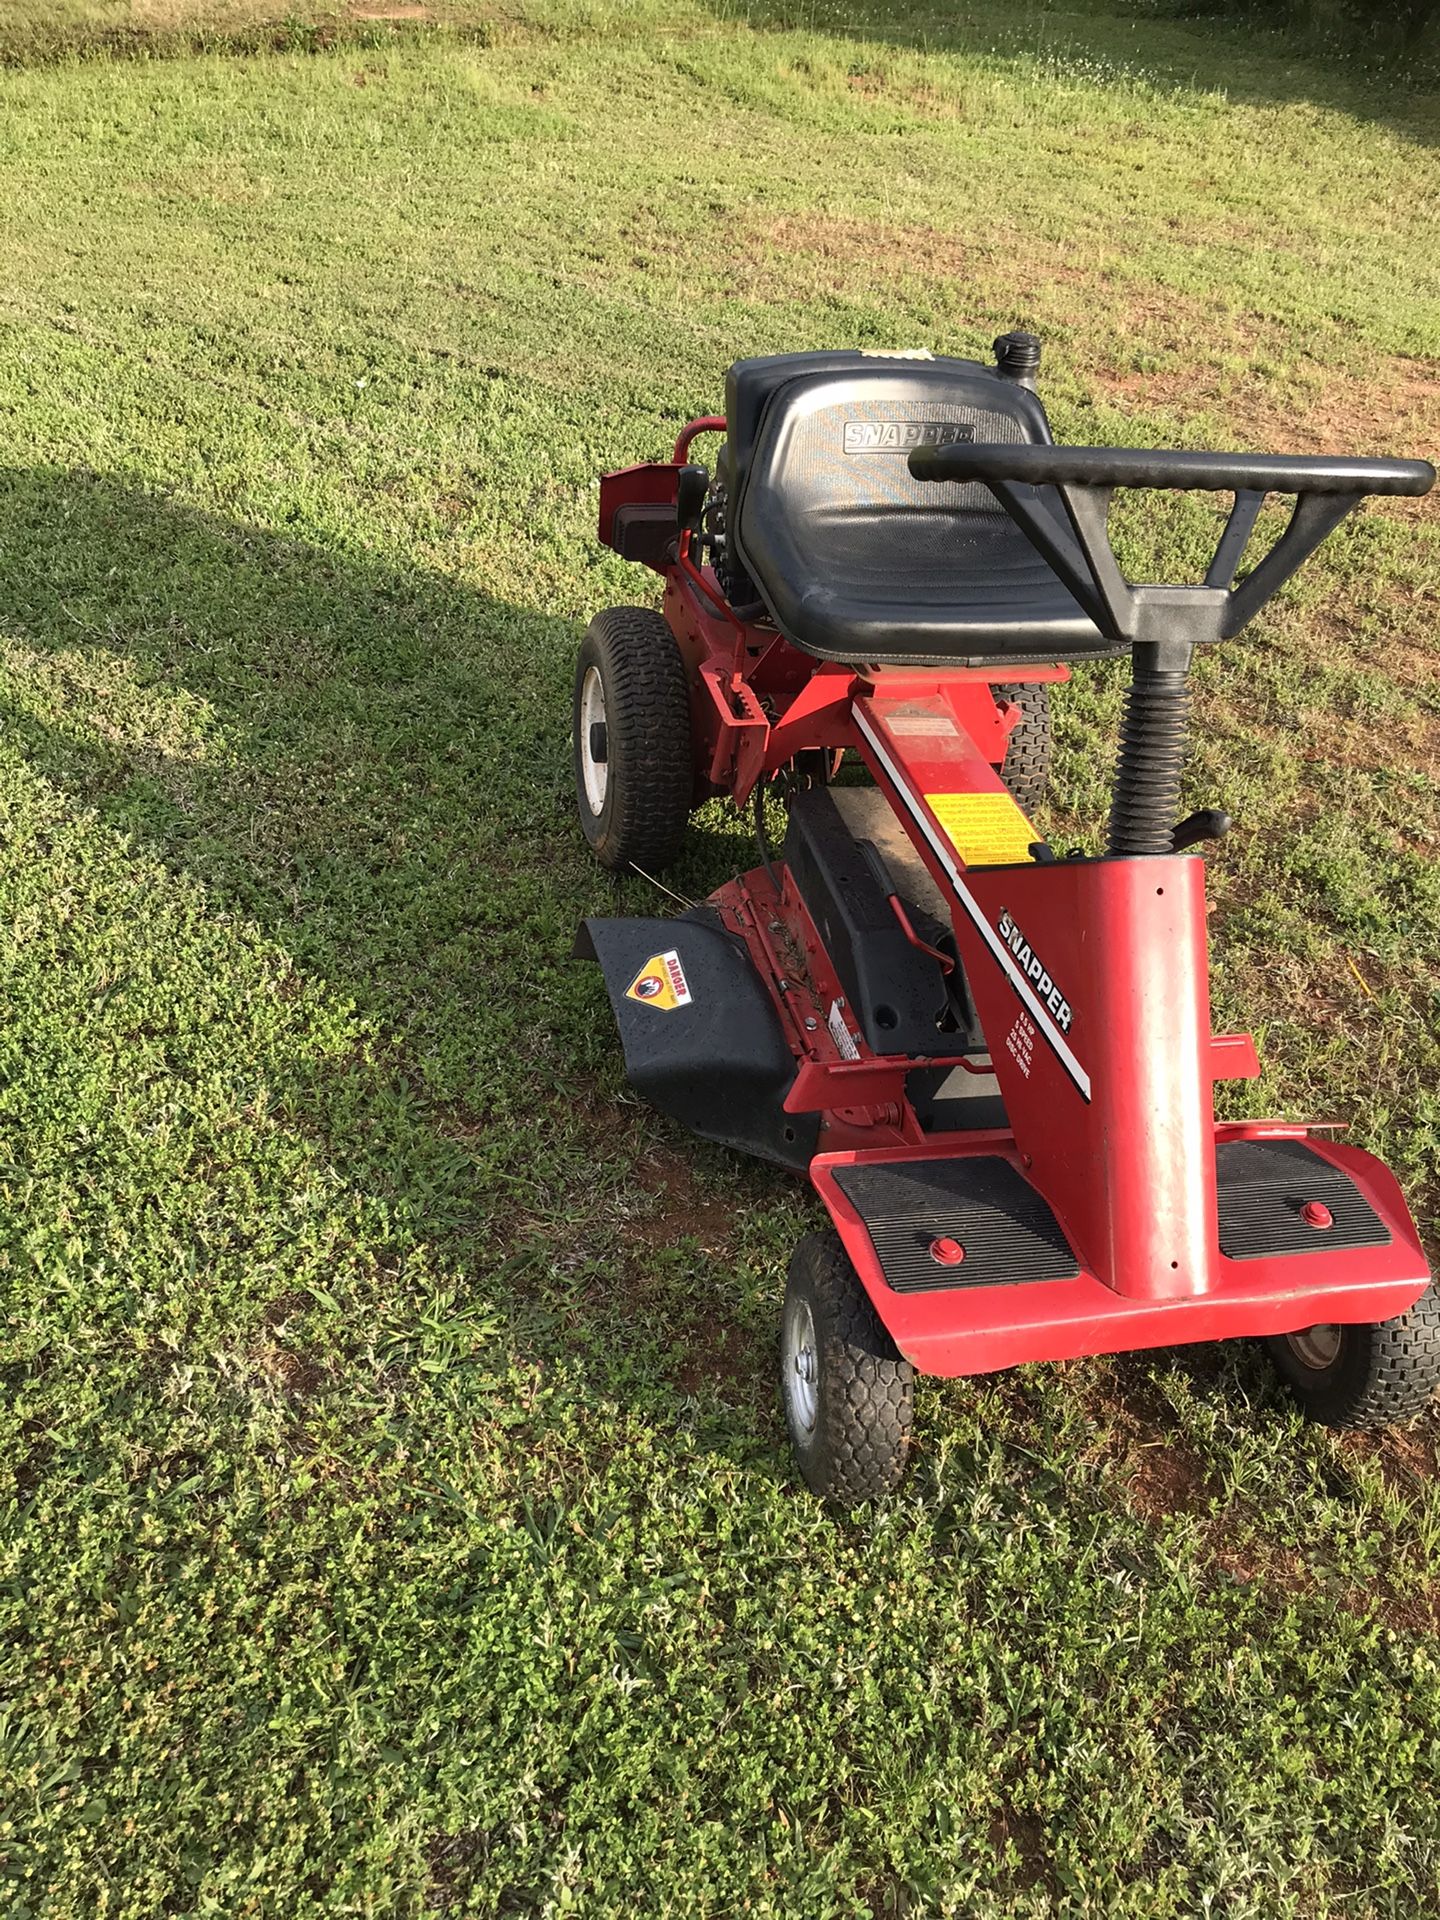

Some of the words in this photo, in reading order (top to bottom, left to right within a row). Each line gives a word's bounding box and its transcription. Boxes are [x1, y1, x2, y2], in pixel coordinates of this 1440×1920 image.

[847, 424, 974, 445] SNAPPER
[667, 959, 687, 997] DANGER
[1000, 912, 1072, 1033] SNAPPER
[1019, 1025, 1033, 1051] SPEED
